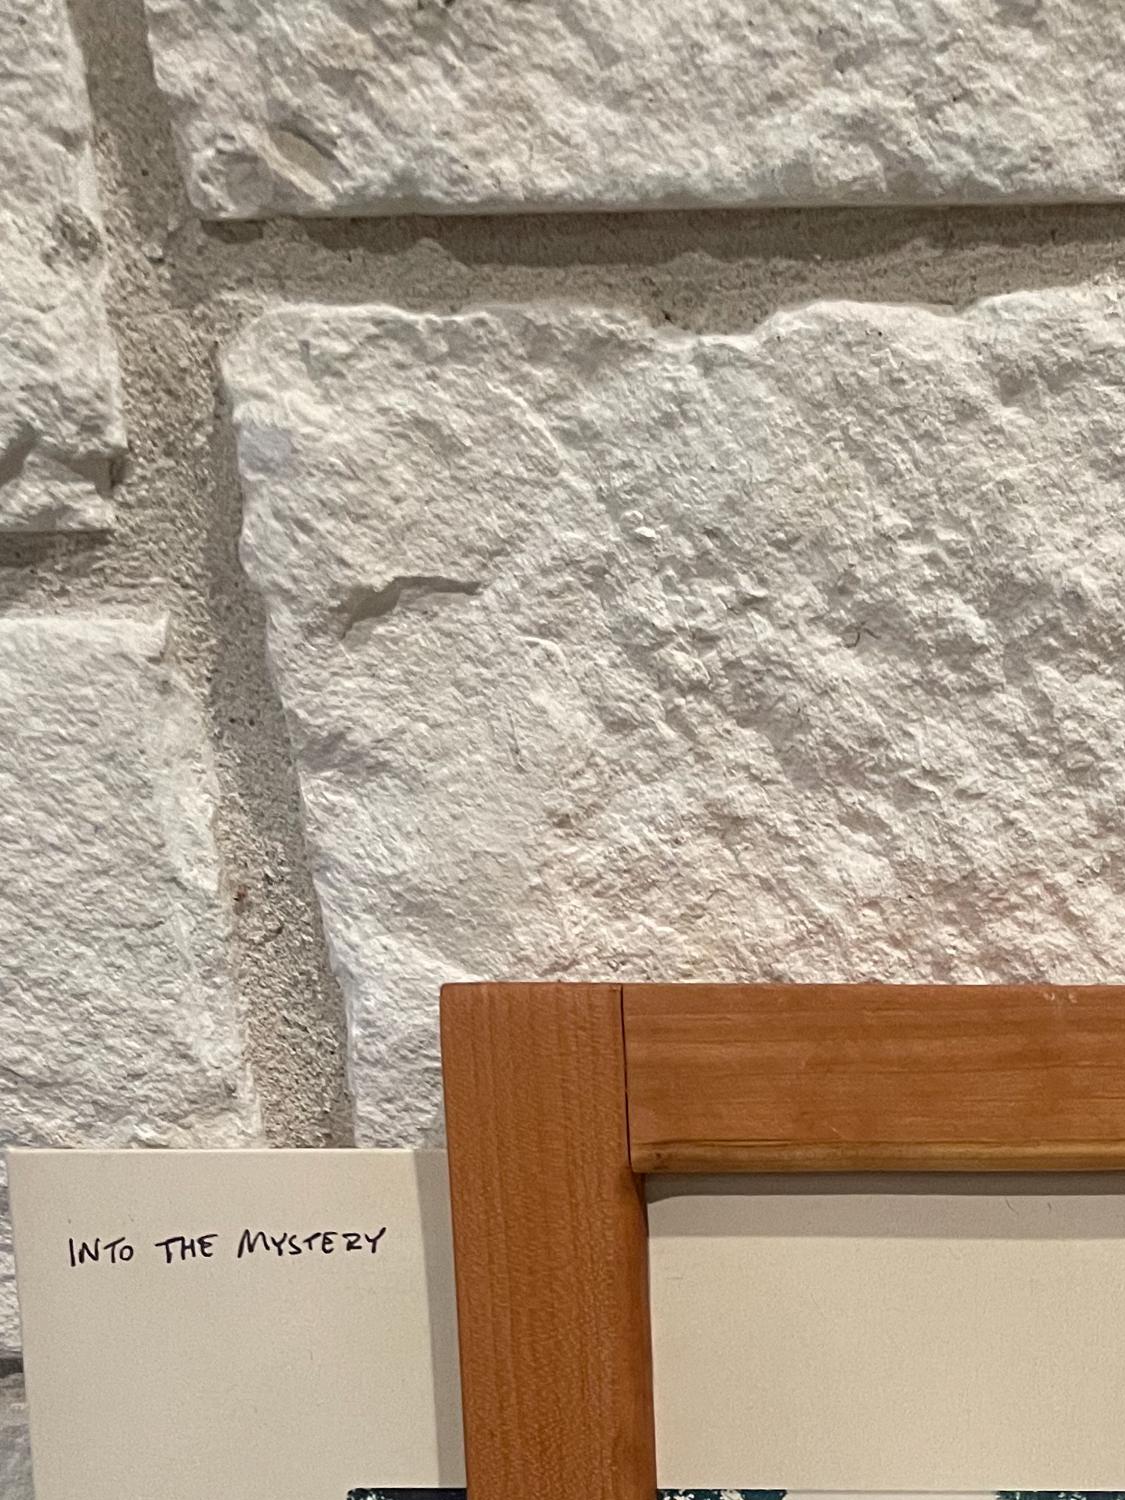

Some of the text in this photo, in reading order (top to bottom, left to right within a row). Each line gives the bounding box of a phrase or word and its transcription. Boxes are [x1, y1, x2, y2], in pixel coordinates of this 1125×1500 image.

[68, 1226, 387, 1267] INTO THE MYSTERY
